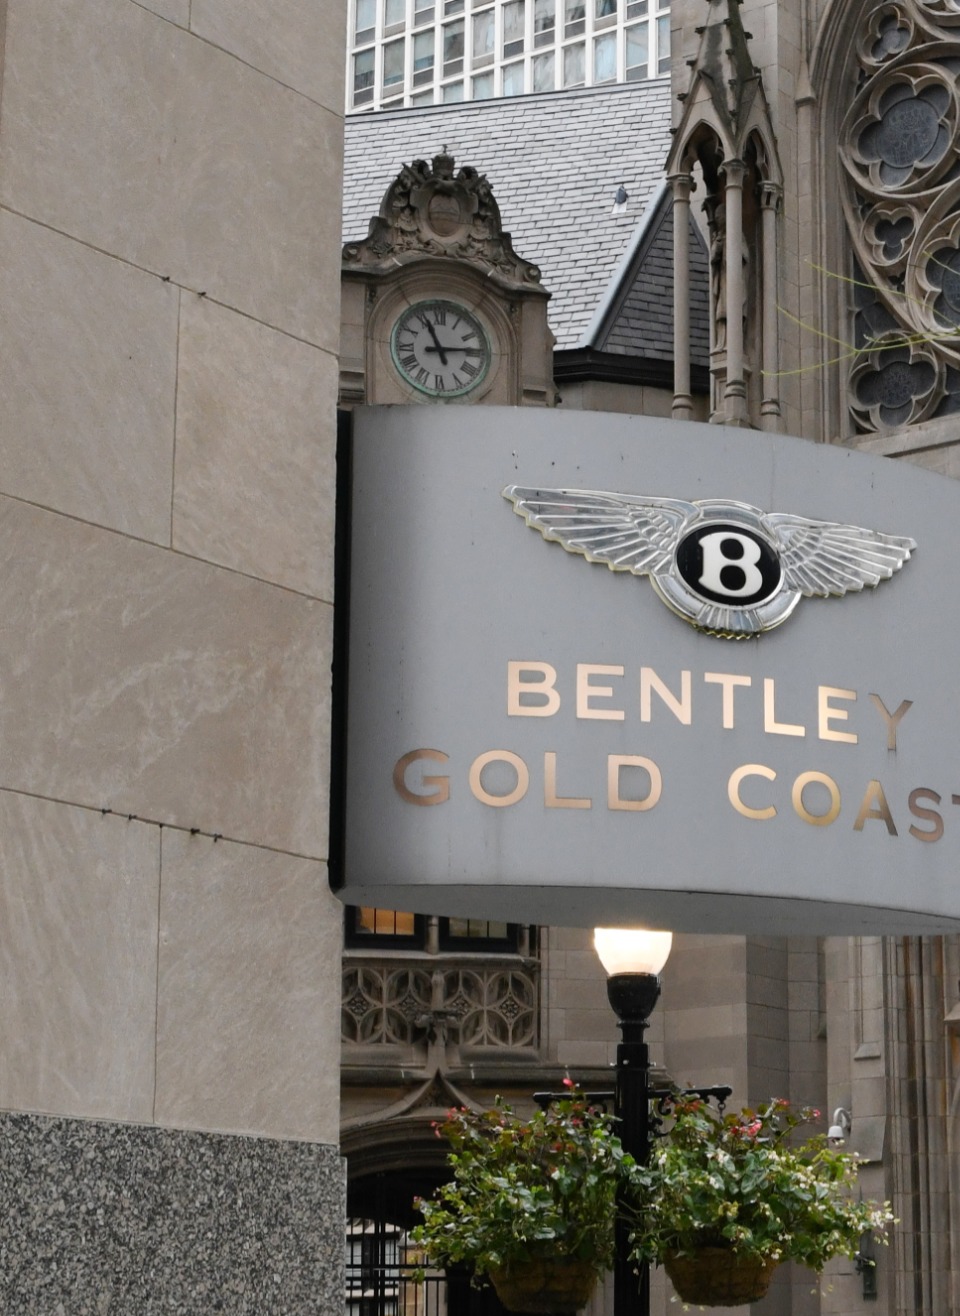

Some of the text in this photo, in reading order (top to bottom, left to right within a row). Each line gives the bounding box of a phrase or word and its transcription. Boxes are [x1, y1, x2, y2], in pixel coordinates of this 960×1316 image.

[699, 532, 764, 597] B
[507, 660, 912, 752] BENTLEY
[393, 748, 662, 811] GOLD
